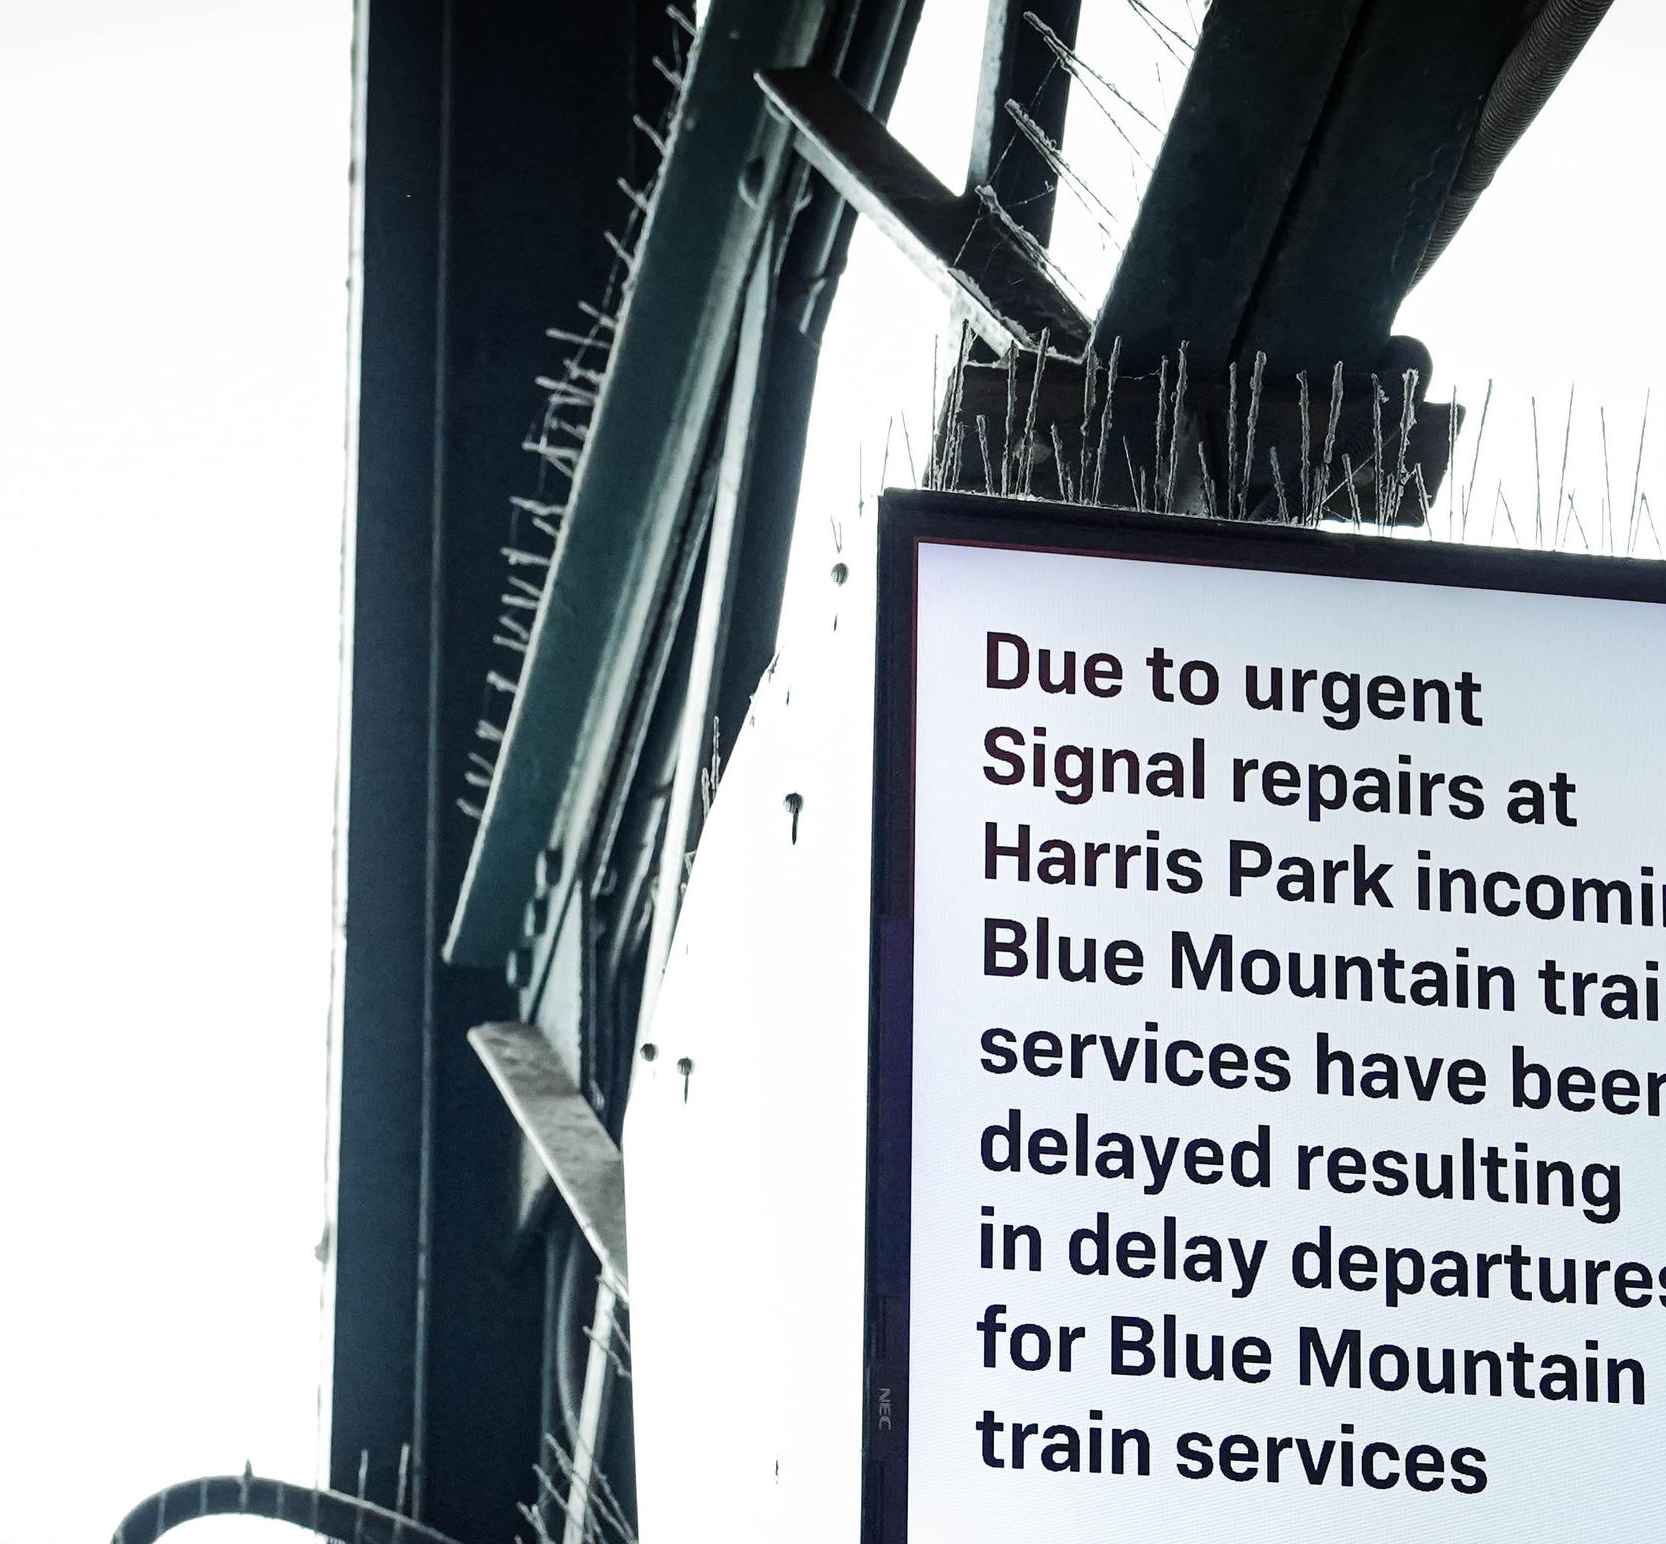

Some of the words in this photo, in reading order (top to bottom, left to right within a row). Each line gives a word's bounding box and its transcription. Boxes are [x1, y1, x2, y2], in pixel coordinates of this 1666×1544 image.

[987, 631, 1122, 698] Due
[1146, 647, 1219, 705] to
[1246, 665, 1482, 730] urgent
[983, 727, 1204, 805] Signal
[1233, 754, 1484, 822] repairs
[1507, 773, 1577, 827] at
[985, 822, 1202, 894] Harris
[1230, 840, 1393, 908] Park
[984, 917, 1143, 986] Blue
[1172, 931, 1515, 1011] Mountain
[981, 1022, 1291, 1092] services
[1317, 1032, 1486, 1105] have
[981, 1109, 1270, 1195] delayed
[1298, 1138, 1620, 1224] resulting
[981, 1206, 1041, 1271] in
[1069, 1212, 1267, 1298] delay
[977, 1304, 1085, 1372] for
[1111, 1314, 1271, 1383] Blue
[1300, 1327, 1644, 1405] Mountain
[878, 1388, 892, 1431] NEC
[976, 1410, 1150, 1476] train
[1177, 1424, 1487, 1494] services
